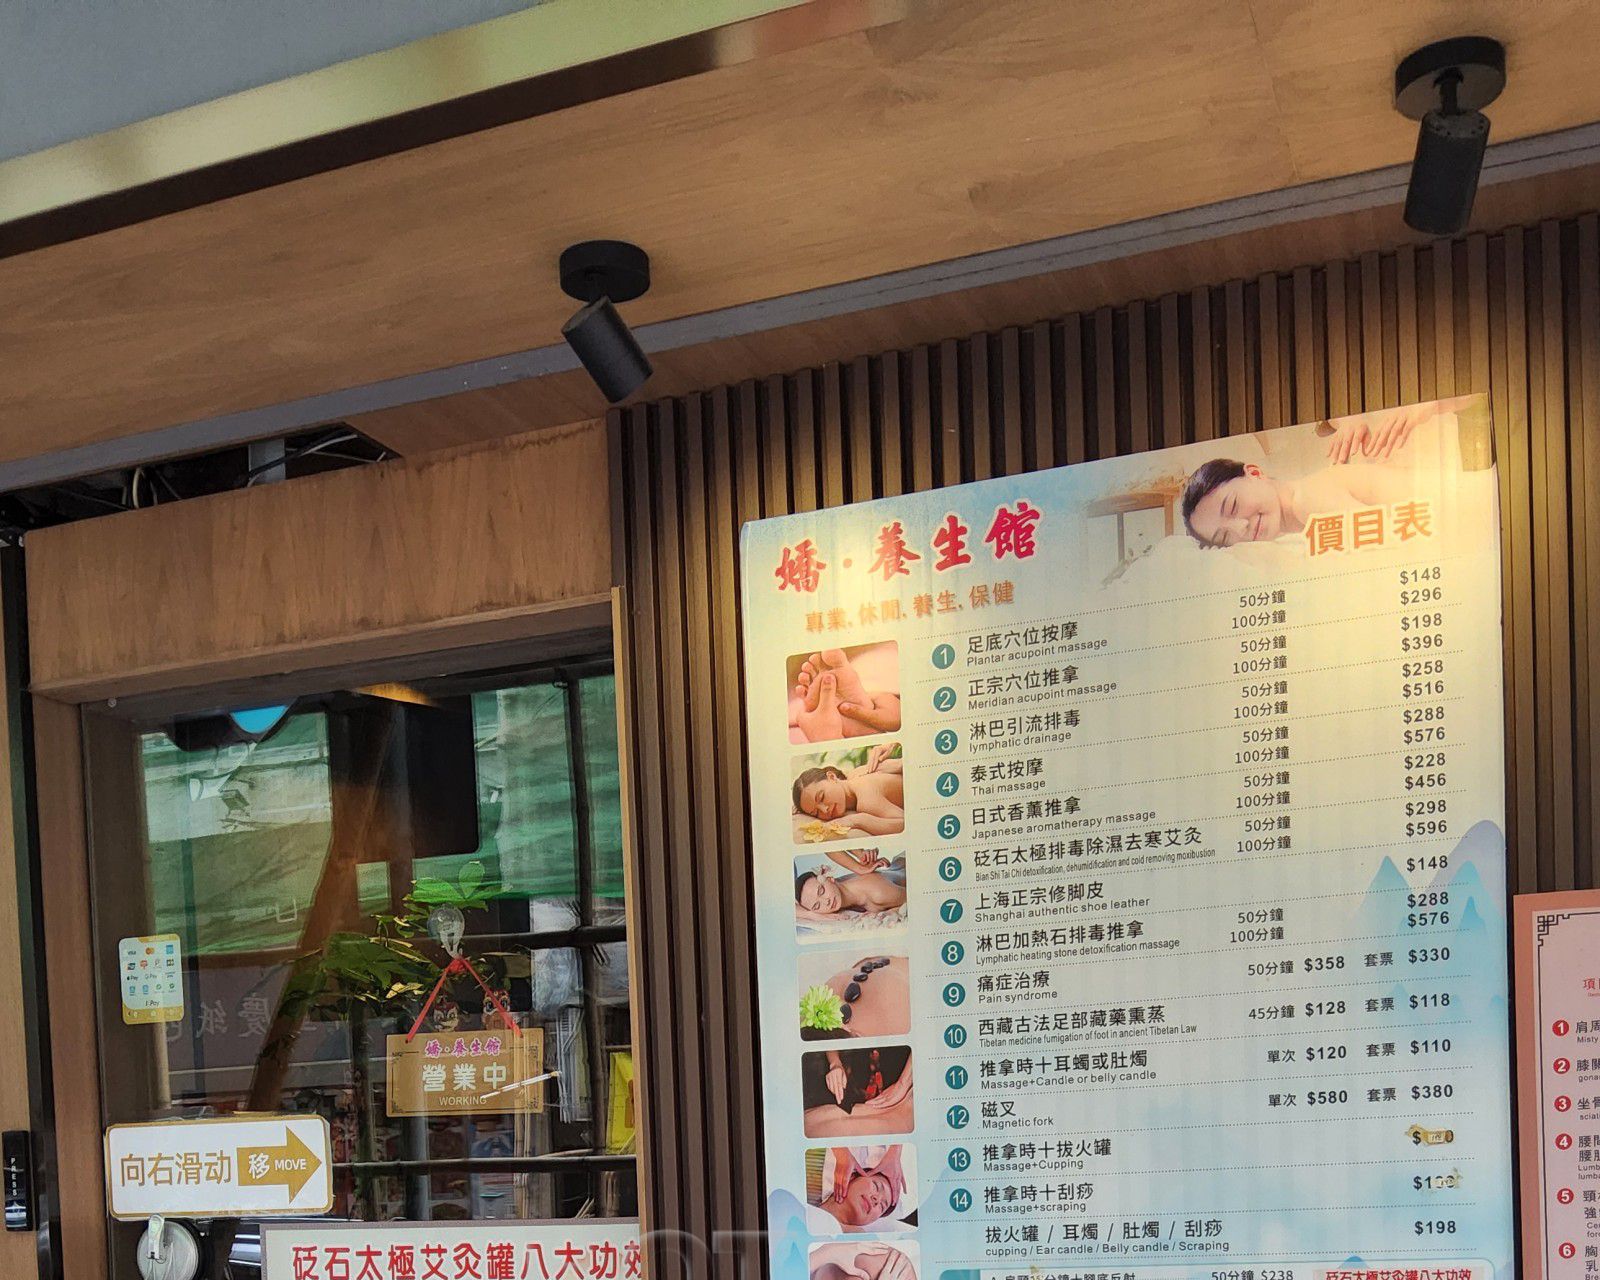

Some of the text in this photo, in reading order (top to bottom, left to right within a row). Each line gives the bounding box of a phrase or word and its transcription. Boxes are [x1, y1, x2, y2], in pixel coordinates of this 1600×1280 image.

[1305, 501, 1433, 557] 價目表
[1240, 566, 1441, 608] 50分鐘 $148
[1232, 586, 1442, 629] 100分鐘 $296
[1401, 612, 1443, 631] $198
[968, 620, 1079, 654] 足底穴位按摩
[1402, 633, 1443, 652] $396
[967, 639, 1108, 666] Plantar acupoint massage
[1403, 659, 1444, 678] $258
[969, 664, 1079, 697] 正宗穴位推拿
[969, 682, 1117, 710] Meridian acupoint massage
[1235, 679, 1444, 719] 100分鐘 $516
[970, 708, 1081, 740] 淋巴引流排毒
[1403, 705, 1445, 724] $288
[970, 731, 1072, 754] lymphatic drainage
[971, 757, 1044, 782] 泰式按摩
[1244, 770, 1290, 787] 50分鐘
[971, 780, 1046, 795] Thai massage
[1405, 772, 1447, 791] $456
[972, 811, 1156, 840] Japanese aromatherapy massage
[1406, 819, 1447, 837] $596
[1407, 855, 1448, 872] $148
[975, 897, 1151, 922] Shanghai authentic shoe leather
[1408, 891, 1449, 909] $288
[976, 919, 1144, 952] 淋巴加熱石排毒推拿
[1231, 910, 1450, 943] 100分鐘 $576
[1248, 946, 1450, 975] 50分鐘 $358 套票 $330
[978, 969, 1050, 992] 痛症治療
[979, 990, 1058, 1003] Pain syndrome
[1249, 992, 1451, 1019] 45分鐘 $128 $118
[1267, 1038, 1451, 1063] 單次 $120 套票 $110
[422, 1062, 507, 1093] 營業中
[439, 1096, 487, 1107] WORKING
[1308, 1084, 1454, 1106] $580 $380
[981, 1100, 1017, 1118] 磁叉
[983, 1116, 1054, 1130] Magnetic fork
[120, 1150, 307, 1187] 向右滑动 移 MOVE
[984, 1158, 1084, 1172] Massage+Cupping
[986, 1201, 1087, 1214] Massage+scraping
[1415, 1220, 1457, 1235] $198
[986, 1240, 1230, 1257] cupping Ear candle Belly candle Scraping
